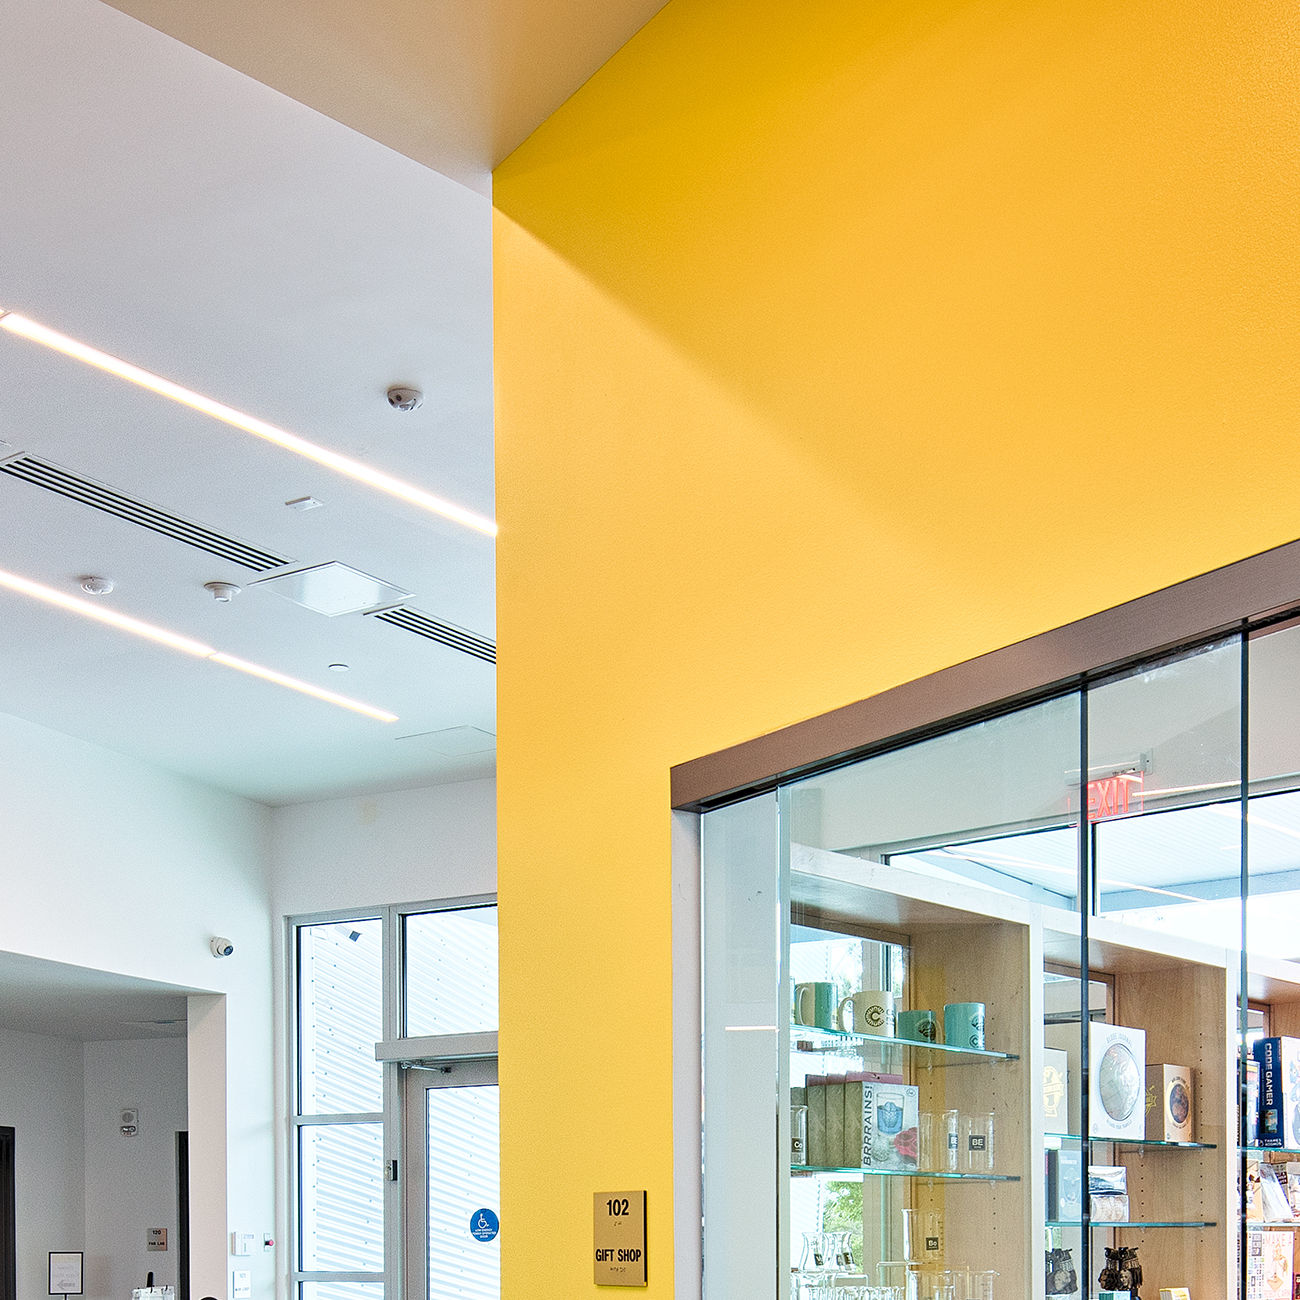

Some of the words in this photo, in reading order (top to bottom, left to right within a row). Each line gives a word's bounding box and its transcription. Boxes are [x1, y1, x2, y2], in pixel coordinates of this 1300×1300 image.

[1087, 778, 1130, 820] EXIT
[1265, 1042, 1273, 1070] CODE
[1265, 1071, 1273, 1106] GAMER
[864, 1085, 873, 1166] BRRRAINS!
[972, 1138, 984, 1146] BE
[606, 1199, 629, 1216] 102
[1265, 1233, 1286, 1247] MAKE
[596, 1249, 614, 1262] GIFT
[618, 1249, 641, 1262] SHOP
